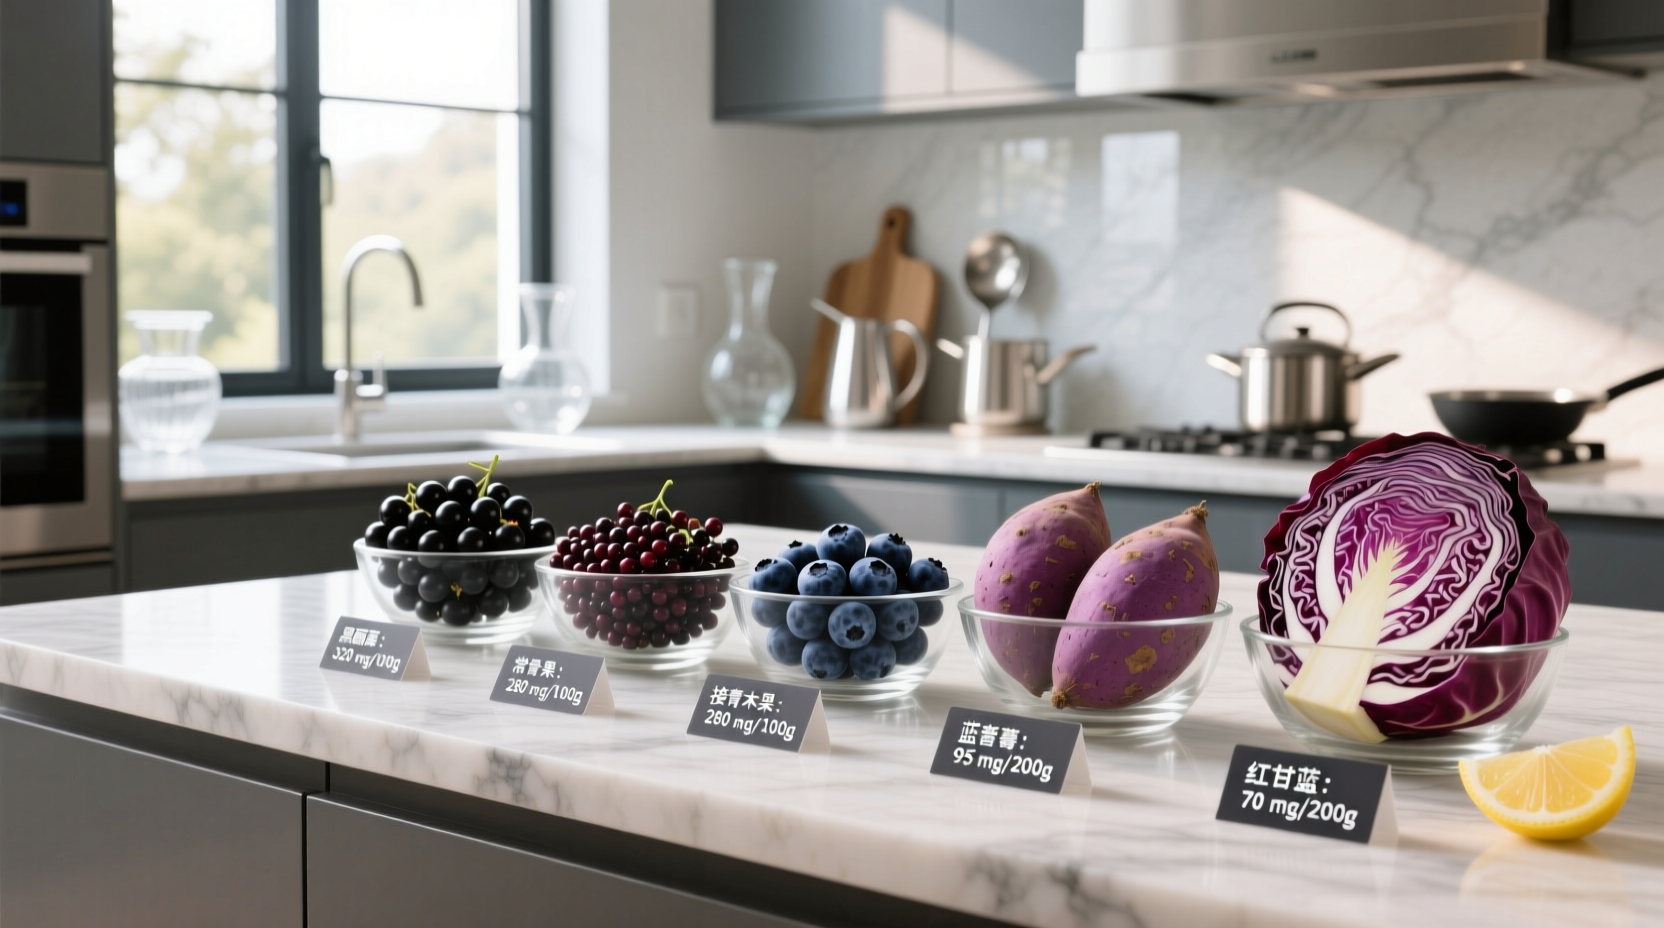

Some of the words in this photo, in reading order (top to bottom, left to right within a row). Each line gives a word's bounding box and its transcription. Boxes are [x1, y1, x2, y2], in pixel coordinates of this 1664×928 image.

[528, 684, 584, 706] mg/100g
[704, 709, 731, 727] 280
[732, 717, 796, 742] mg/100g
[953, 747, 977, 766] 95
[976, 753, 1054, 783] mg/200g
[1241, 790, 1265, 811] 70
[1268, 797, 1359, 831] mg/200g
